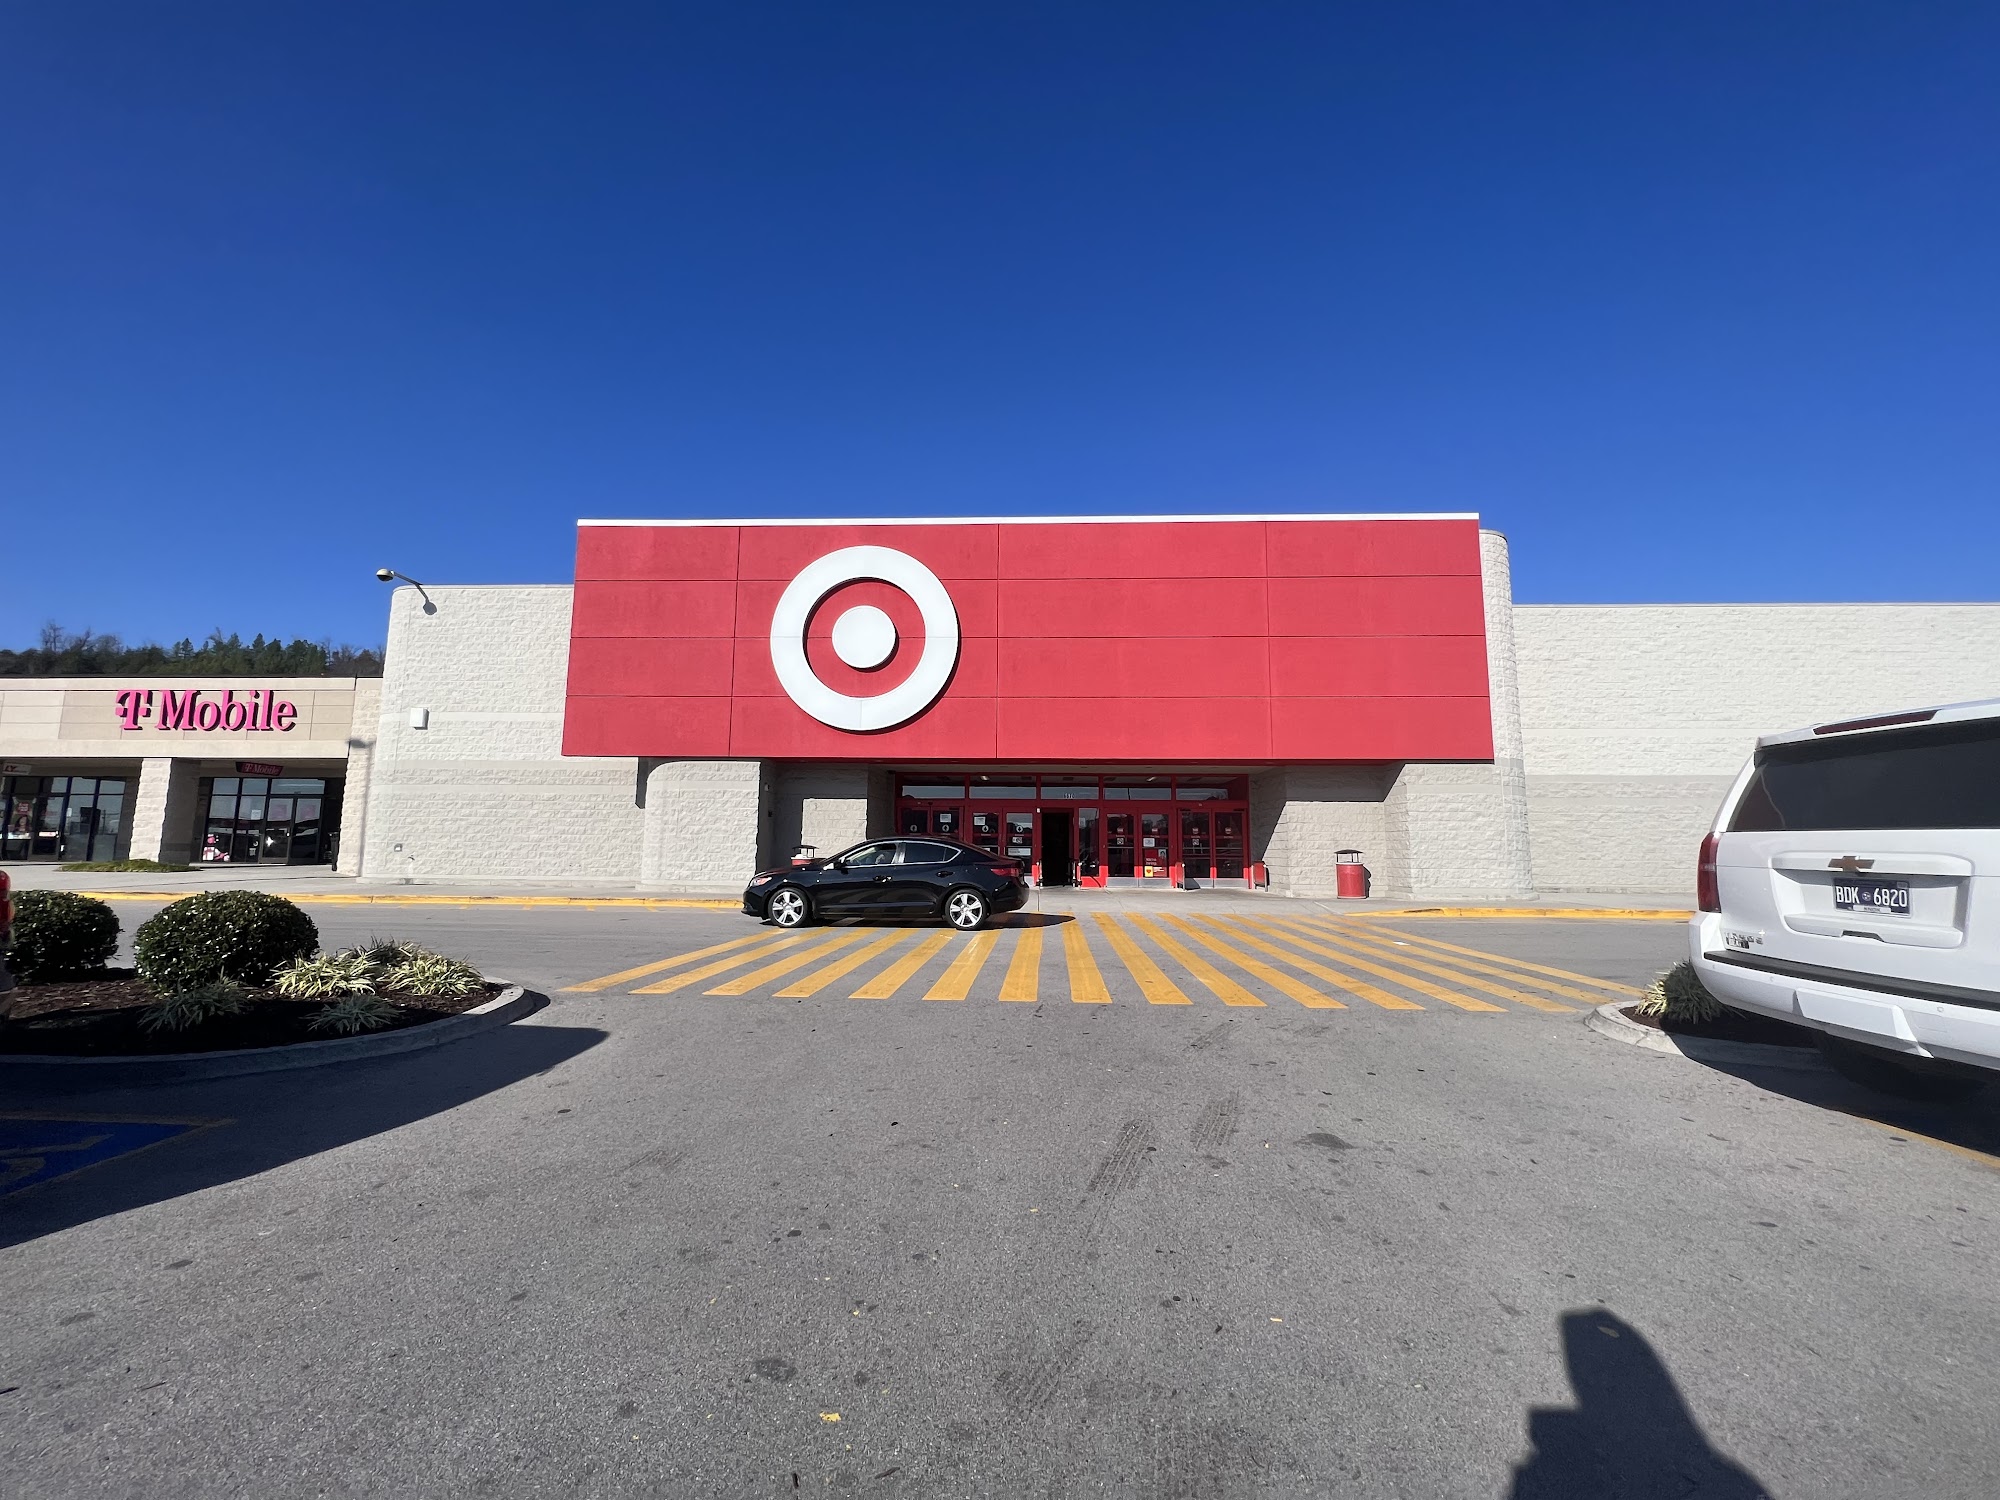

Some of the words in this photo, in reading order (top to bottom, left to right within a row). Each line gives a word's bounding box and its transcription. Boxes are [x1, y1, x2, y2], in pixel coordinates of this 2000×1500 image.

[155, 689, 297, 731] Mobile
[1835, 886, 1860, 904] BDK
[1873, 887, 1908, 907] 6820
